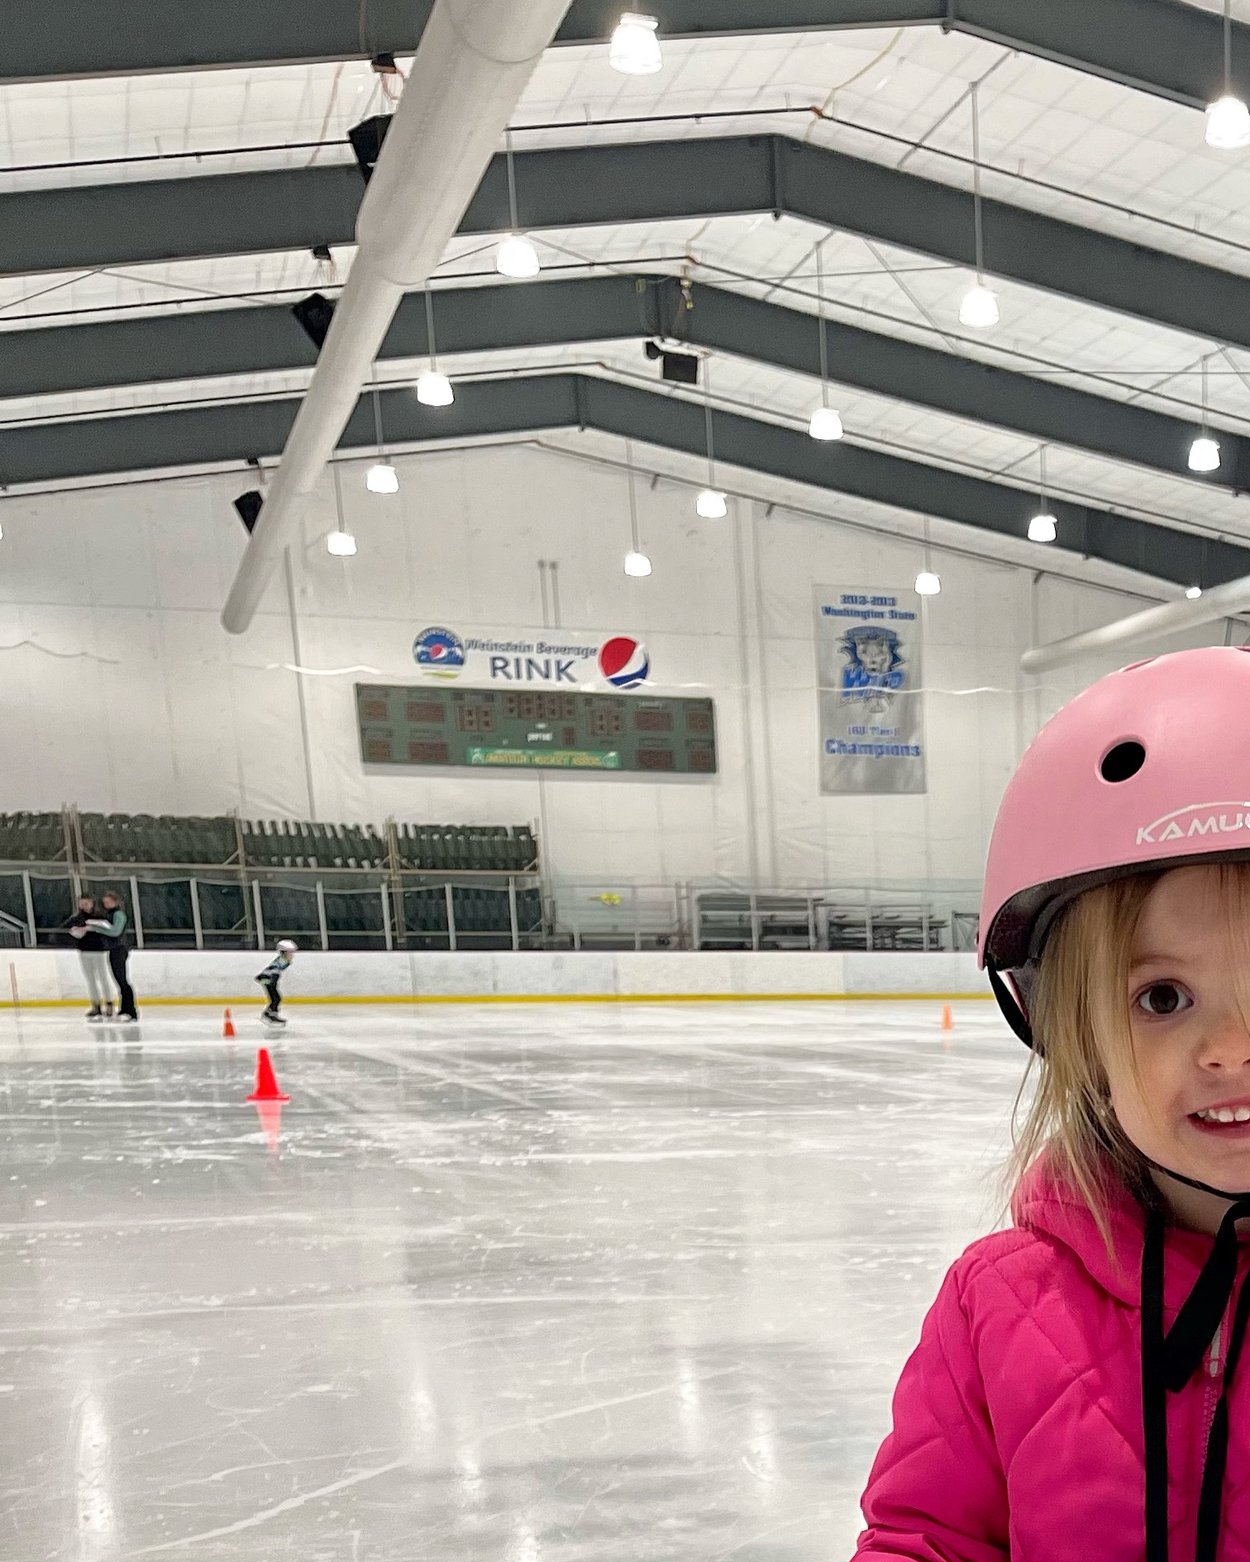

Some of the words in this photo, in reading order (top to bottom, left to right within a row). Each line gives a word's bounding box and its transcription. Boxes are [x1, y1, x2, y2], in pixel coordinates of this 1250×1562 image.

[821, 606, 884, 620] Washington
[888, 611, 917, 620] State
[465, 639, 533, 654] Weinstein
[536, 642, 597, 659] Beverage
[490, 656, 579, 682] RINK
[825, 740, 921, 759] Champions
